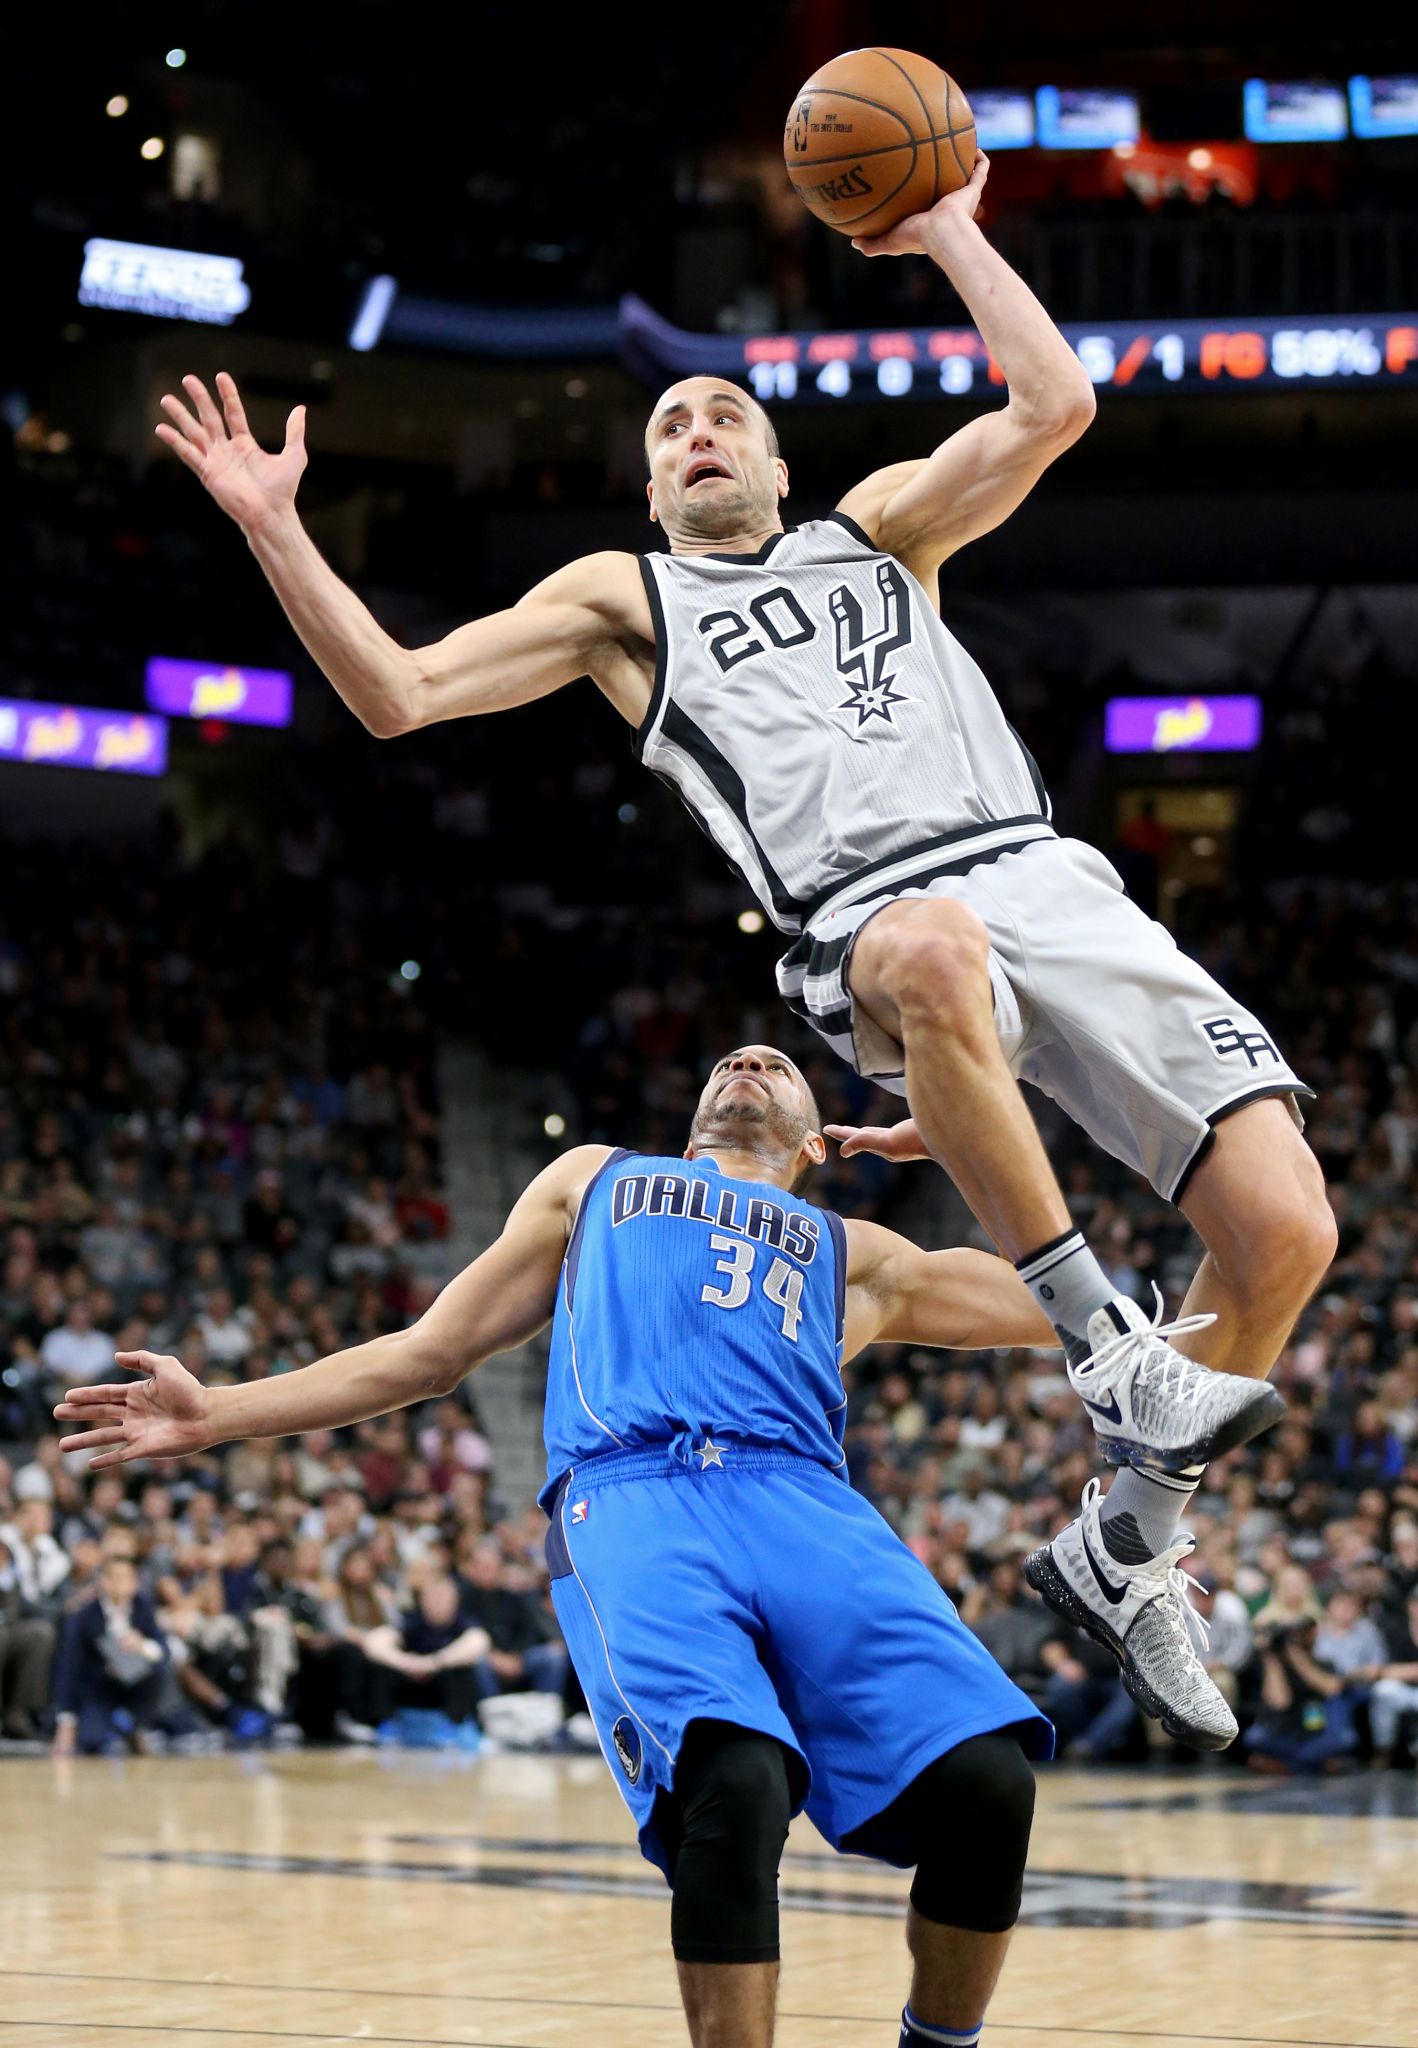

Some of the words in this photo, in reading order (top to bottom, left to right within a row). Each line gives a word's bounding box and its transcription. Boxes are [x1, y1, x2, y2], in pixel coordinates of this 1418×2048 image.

[749, 361, 797, 399] 11
[816, 358, 851, 397] 4
[939, 355, 974, 394] 3
[695, 583, 820, 680] 20
[1200, 1016, 1281, 1069] SA
[612, 1174, 820, 1266] DALLAS
[701, 1233, 805, 1344] 34
